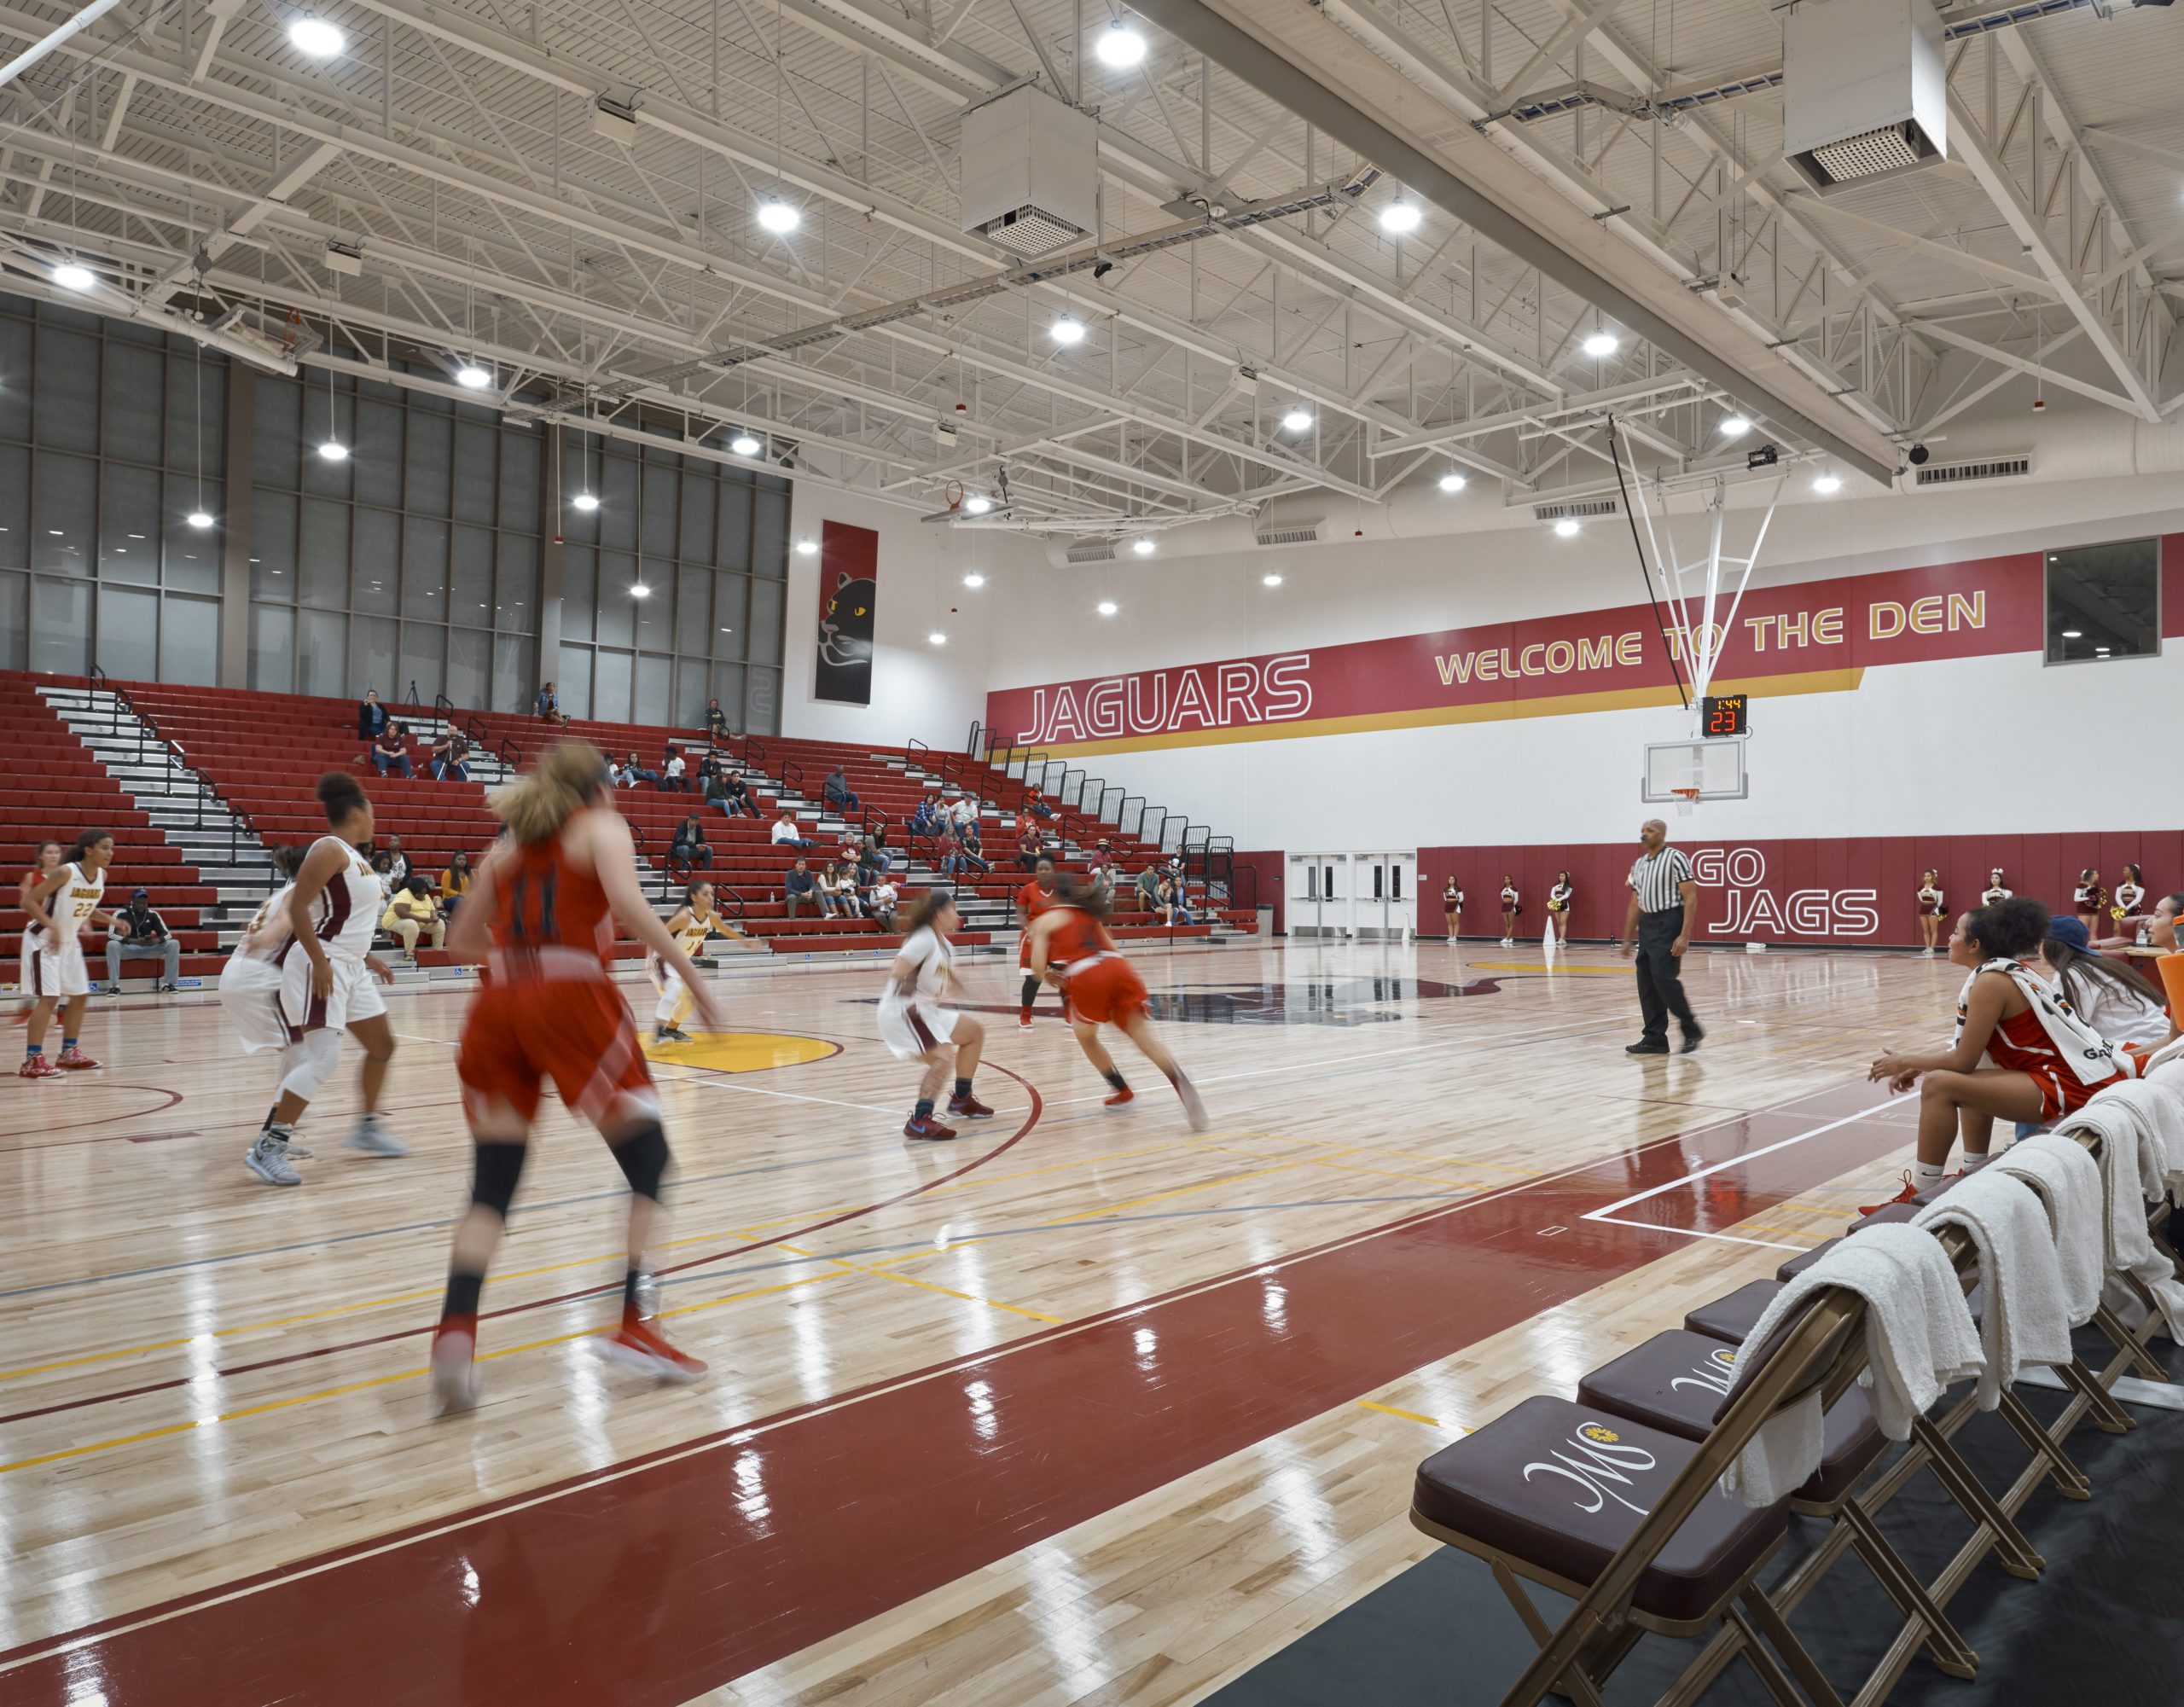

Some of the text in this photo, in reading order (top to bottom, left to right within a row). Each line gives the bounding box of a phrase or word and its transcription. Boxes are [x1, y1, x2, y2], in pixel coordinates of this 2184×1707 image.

[1434, 589, 1986, 685] WELCOME TO THE DEN
[1017, 653, 1312, 745] JAGUARS
[1718, 700, 1740, 710] 1:44
[1711, 711, 1735, 732] 23
[1691, 848, 1765, 887] GO
[73, 903, 93, 917] 22
[1709, 889, 1879, 935] JAGS
